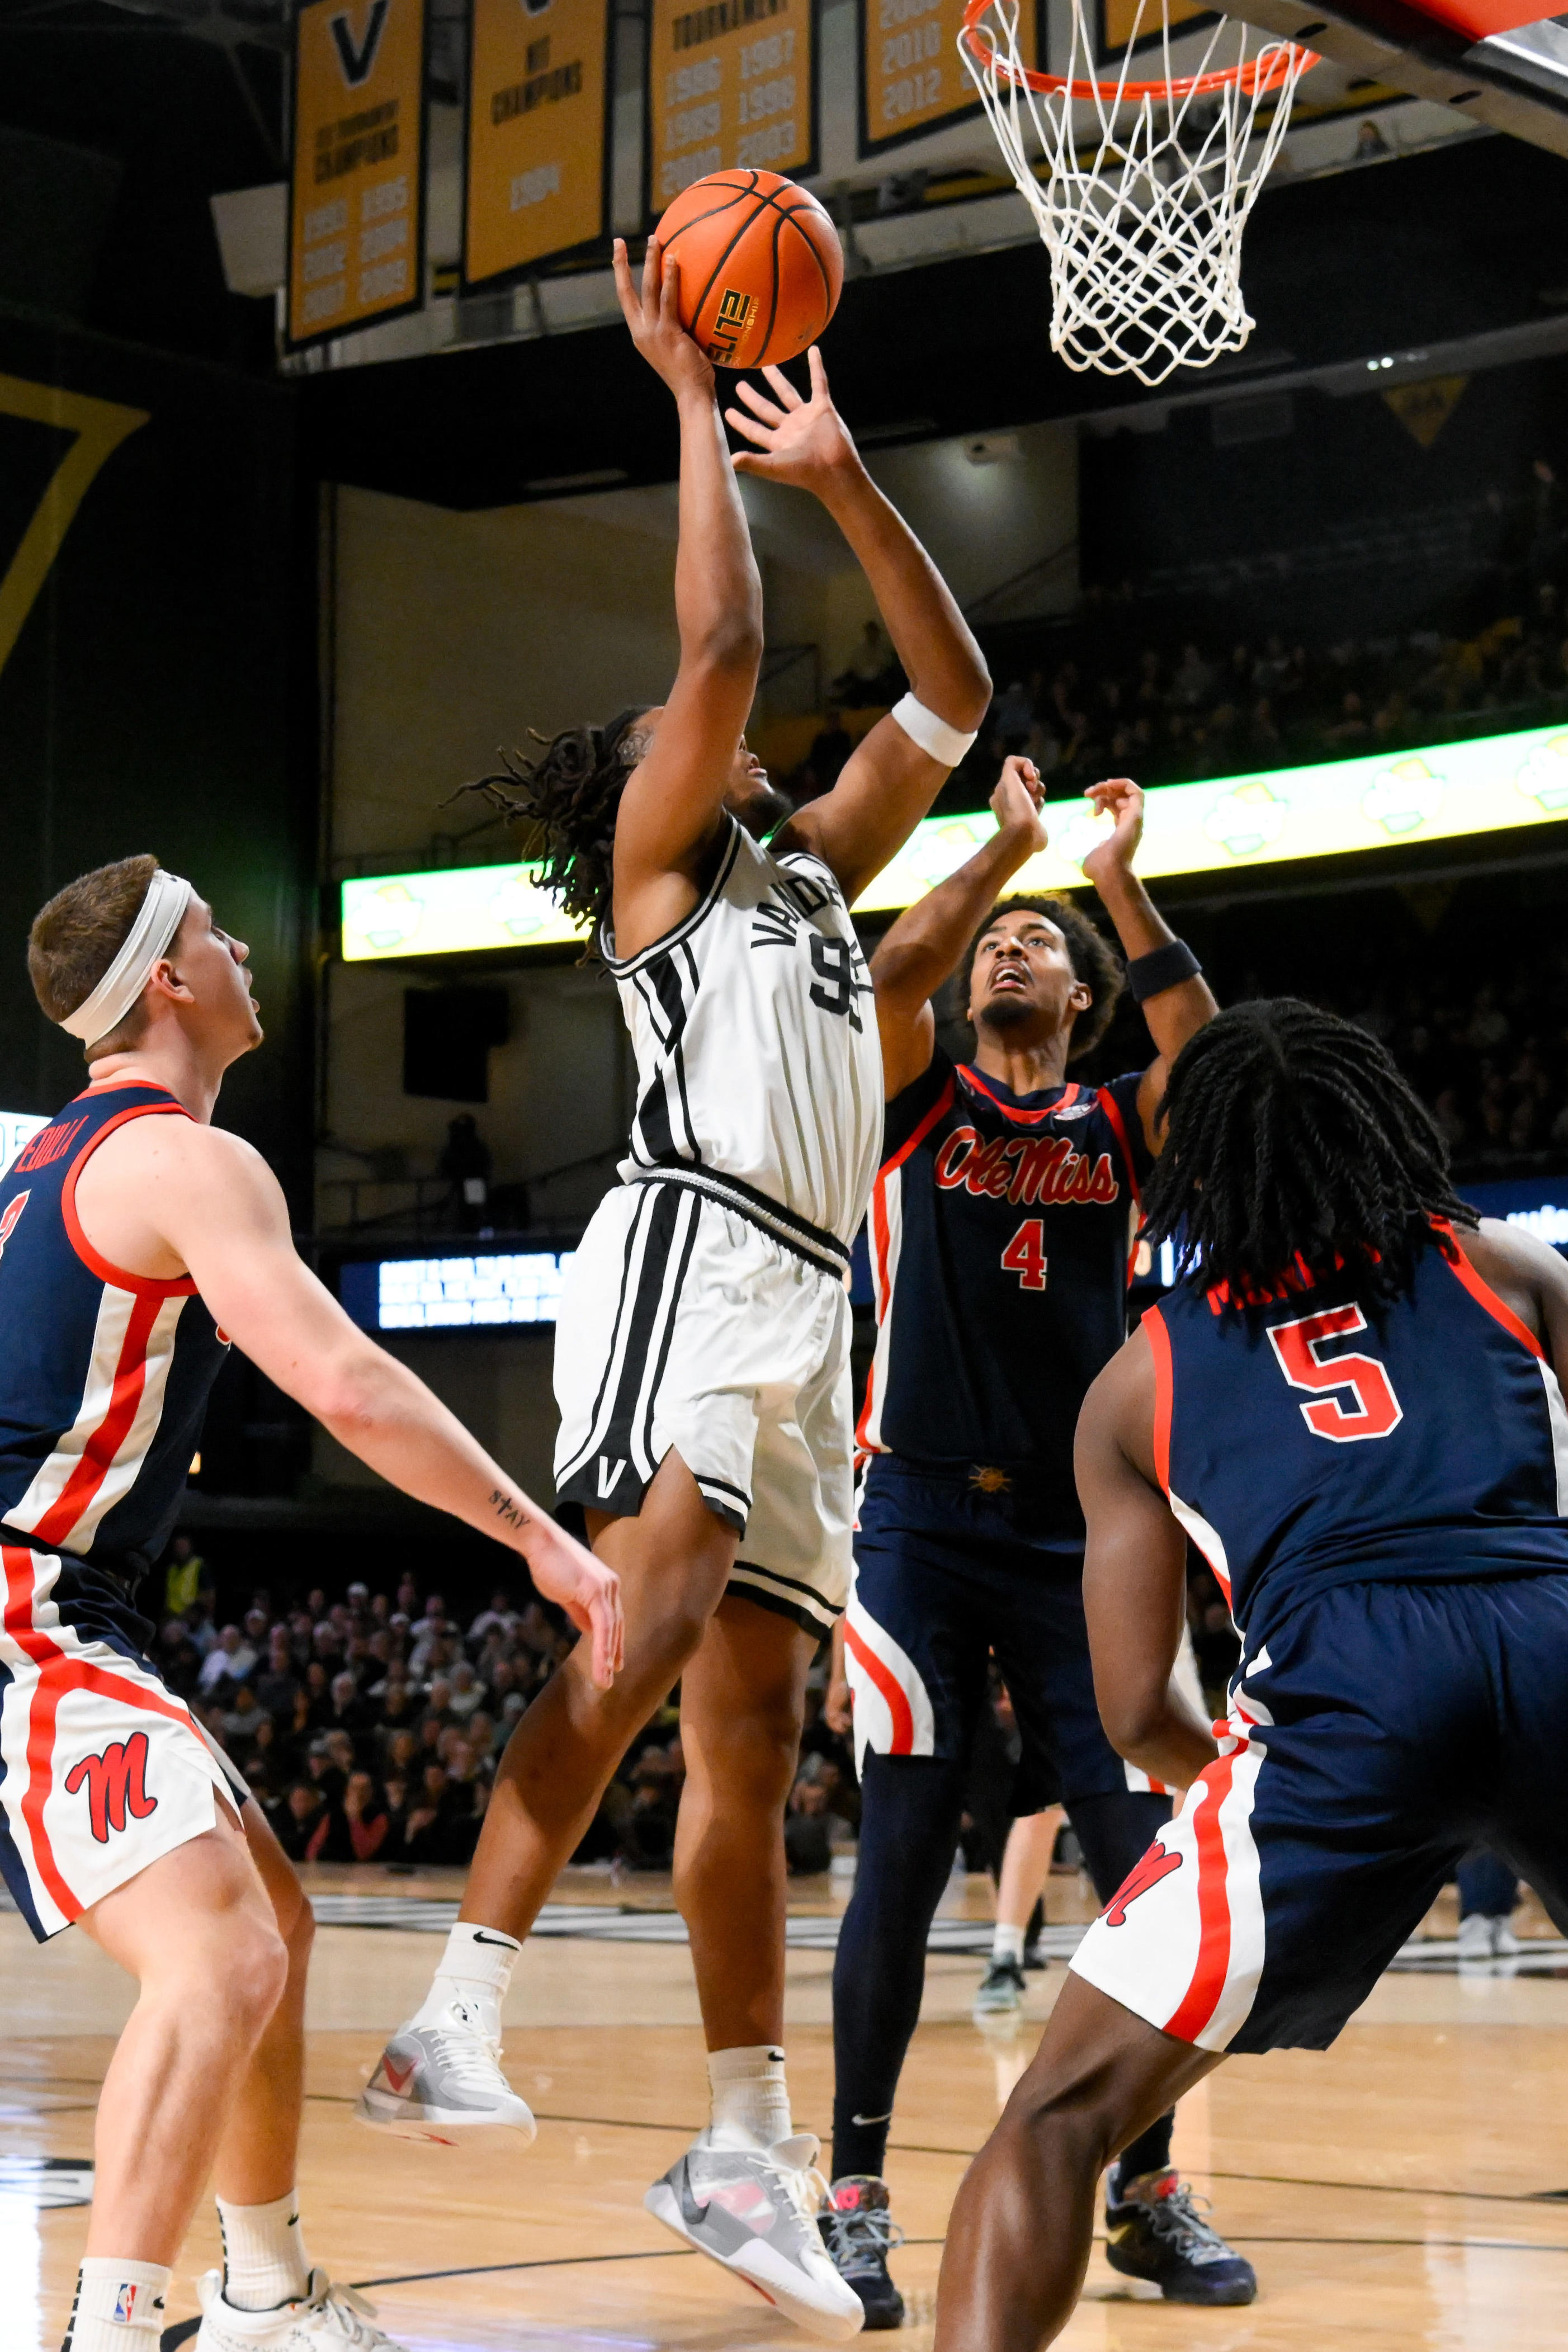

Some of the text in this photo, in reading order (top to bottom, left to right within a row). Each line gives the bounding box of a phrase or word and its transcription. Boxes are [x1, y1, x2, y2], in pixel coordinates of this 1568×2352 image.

[883, 68, 943, 119] 2012
[935, 1125, 1119, 1205] Ole Miss
[1000, 1218, 1048, 1291] 4
[1265, 1301, 1404, 1443] 5
[597, 1455, 627, 1499] V
[64, 1731, 159, 1844] M
